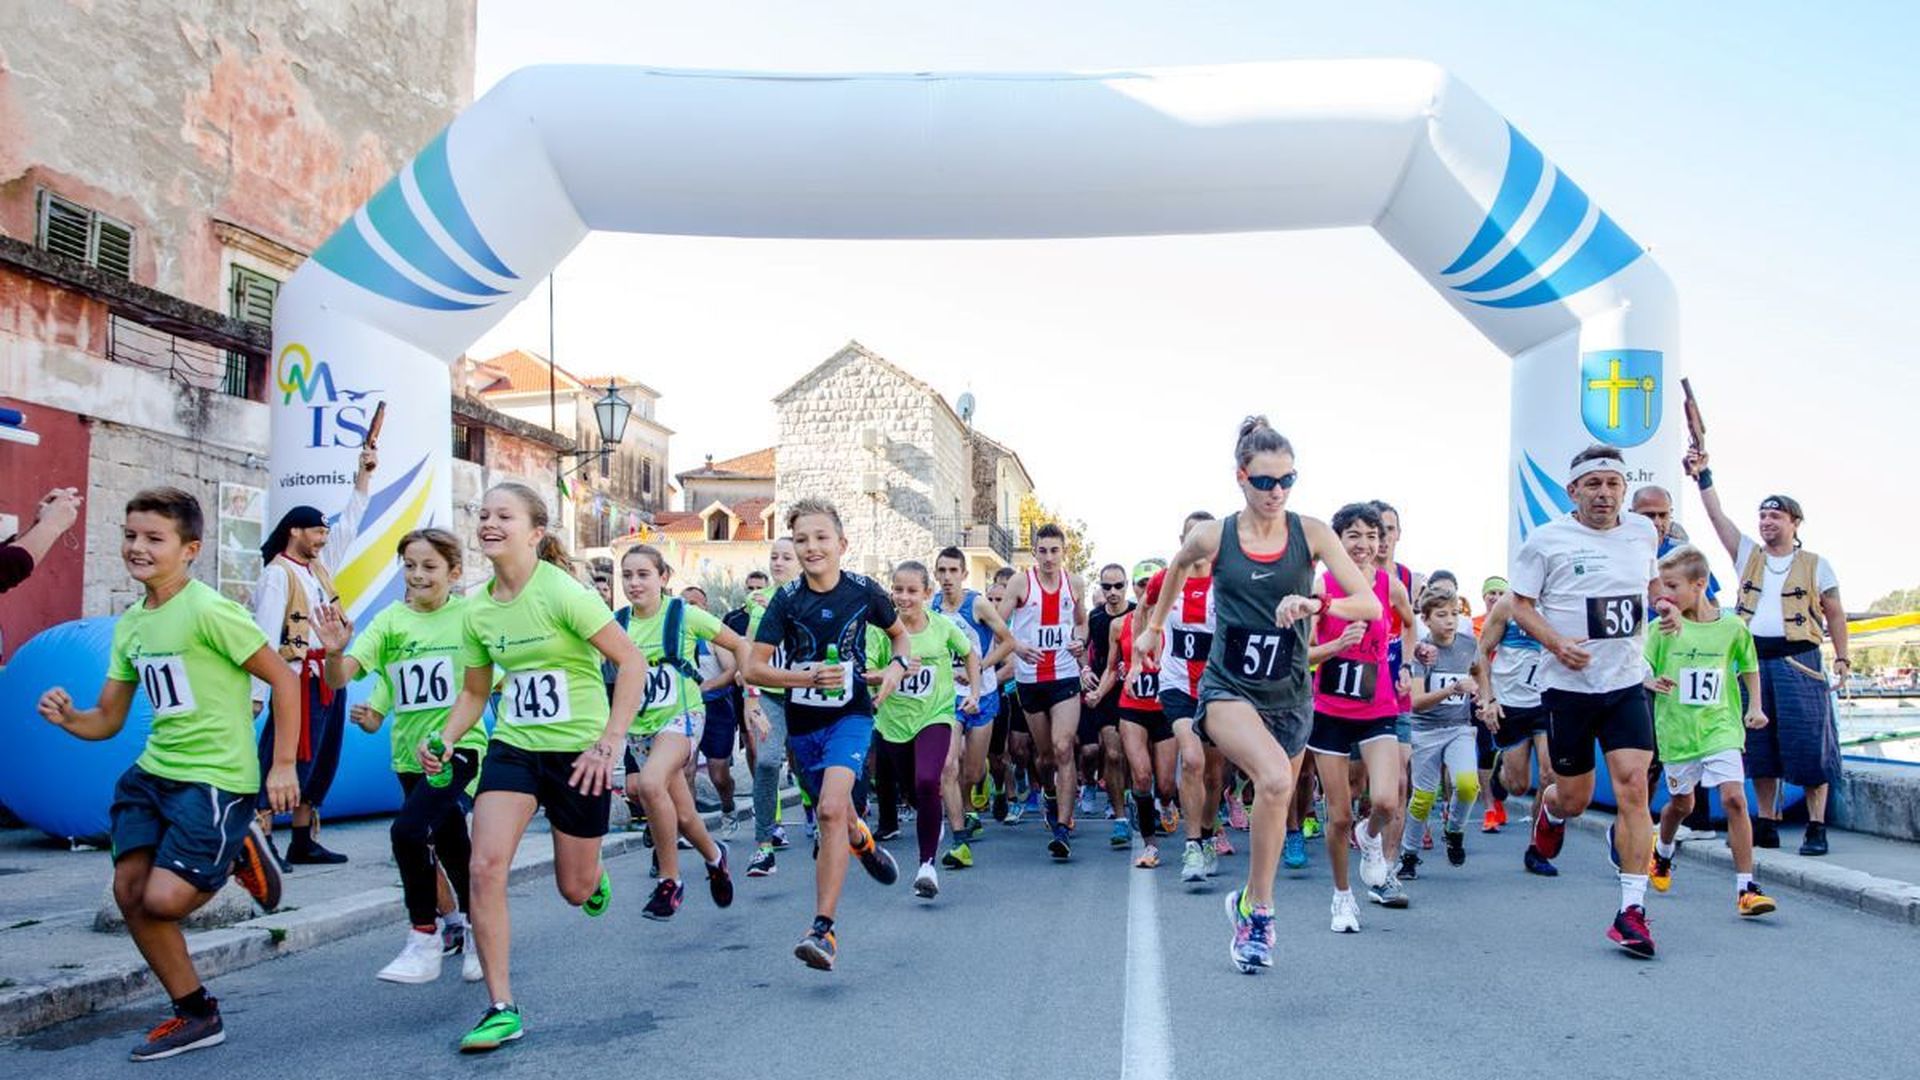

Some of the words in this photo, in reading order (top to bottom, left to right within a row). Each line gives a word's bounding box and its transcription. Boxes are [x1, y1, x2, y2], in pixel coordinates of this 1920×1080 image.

[1606, 599, 1634, 635] 58
[1038, 627, 1063, 648] 104
[1184, 633, 1195, 658] 8
[1243, 634, 1280, 676] 57
[398, 660, 448, 705] 126
[514, 674, 560, 718] 143
[1334, 662, 1364, 696] 11
